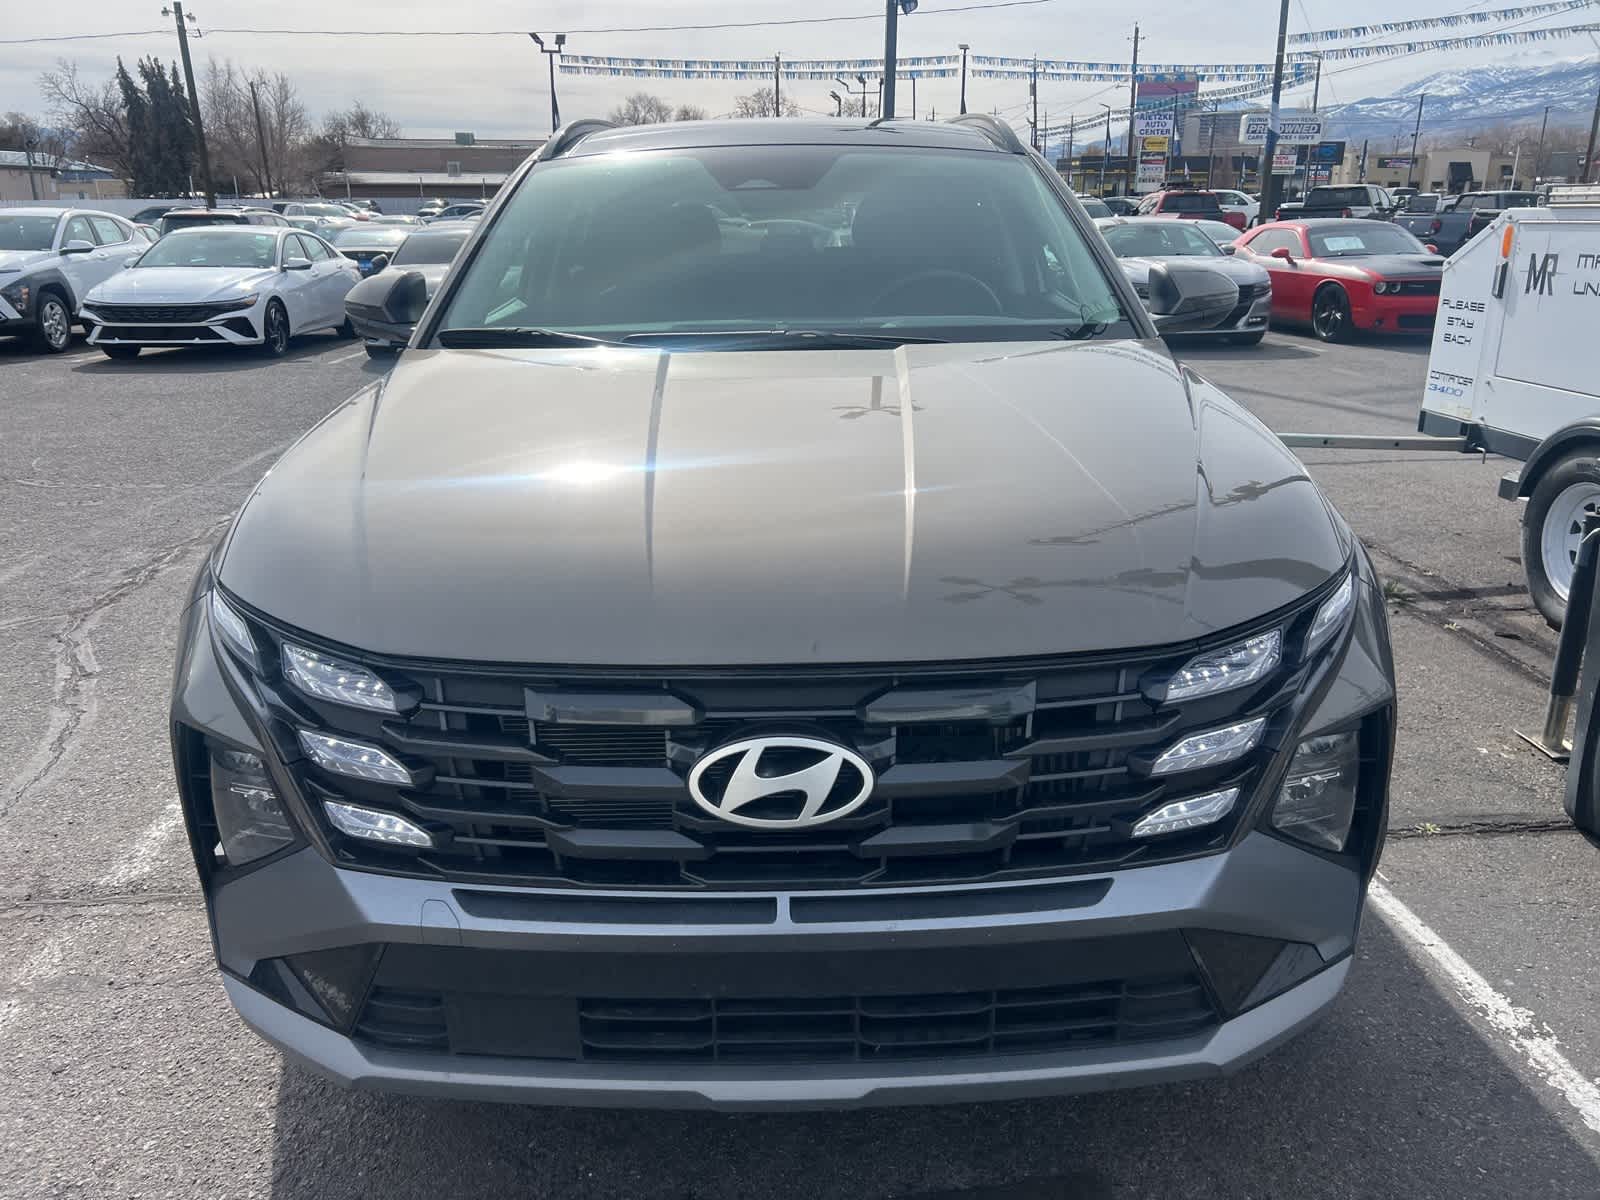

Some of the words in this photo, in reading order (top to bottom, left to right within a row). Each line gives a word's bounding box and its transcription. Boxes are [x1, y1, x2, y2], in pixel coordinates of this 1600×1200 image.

[1441, 298, 1485, 312] PLEASE
[1446, 316, 1475, 328] STAY
[1443, 333, 1472, 345] BACK
[1428, 383, 1463, 397] 3400
